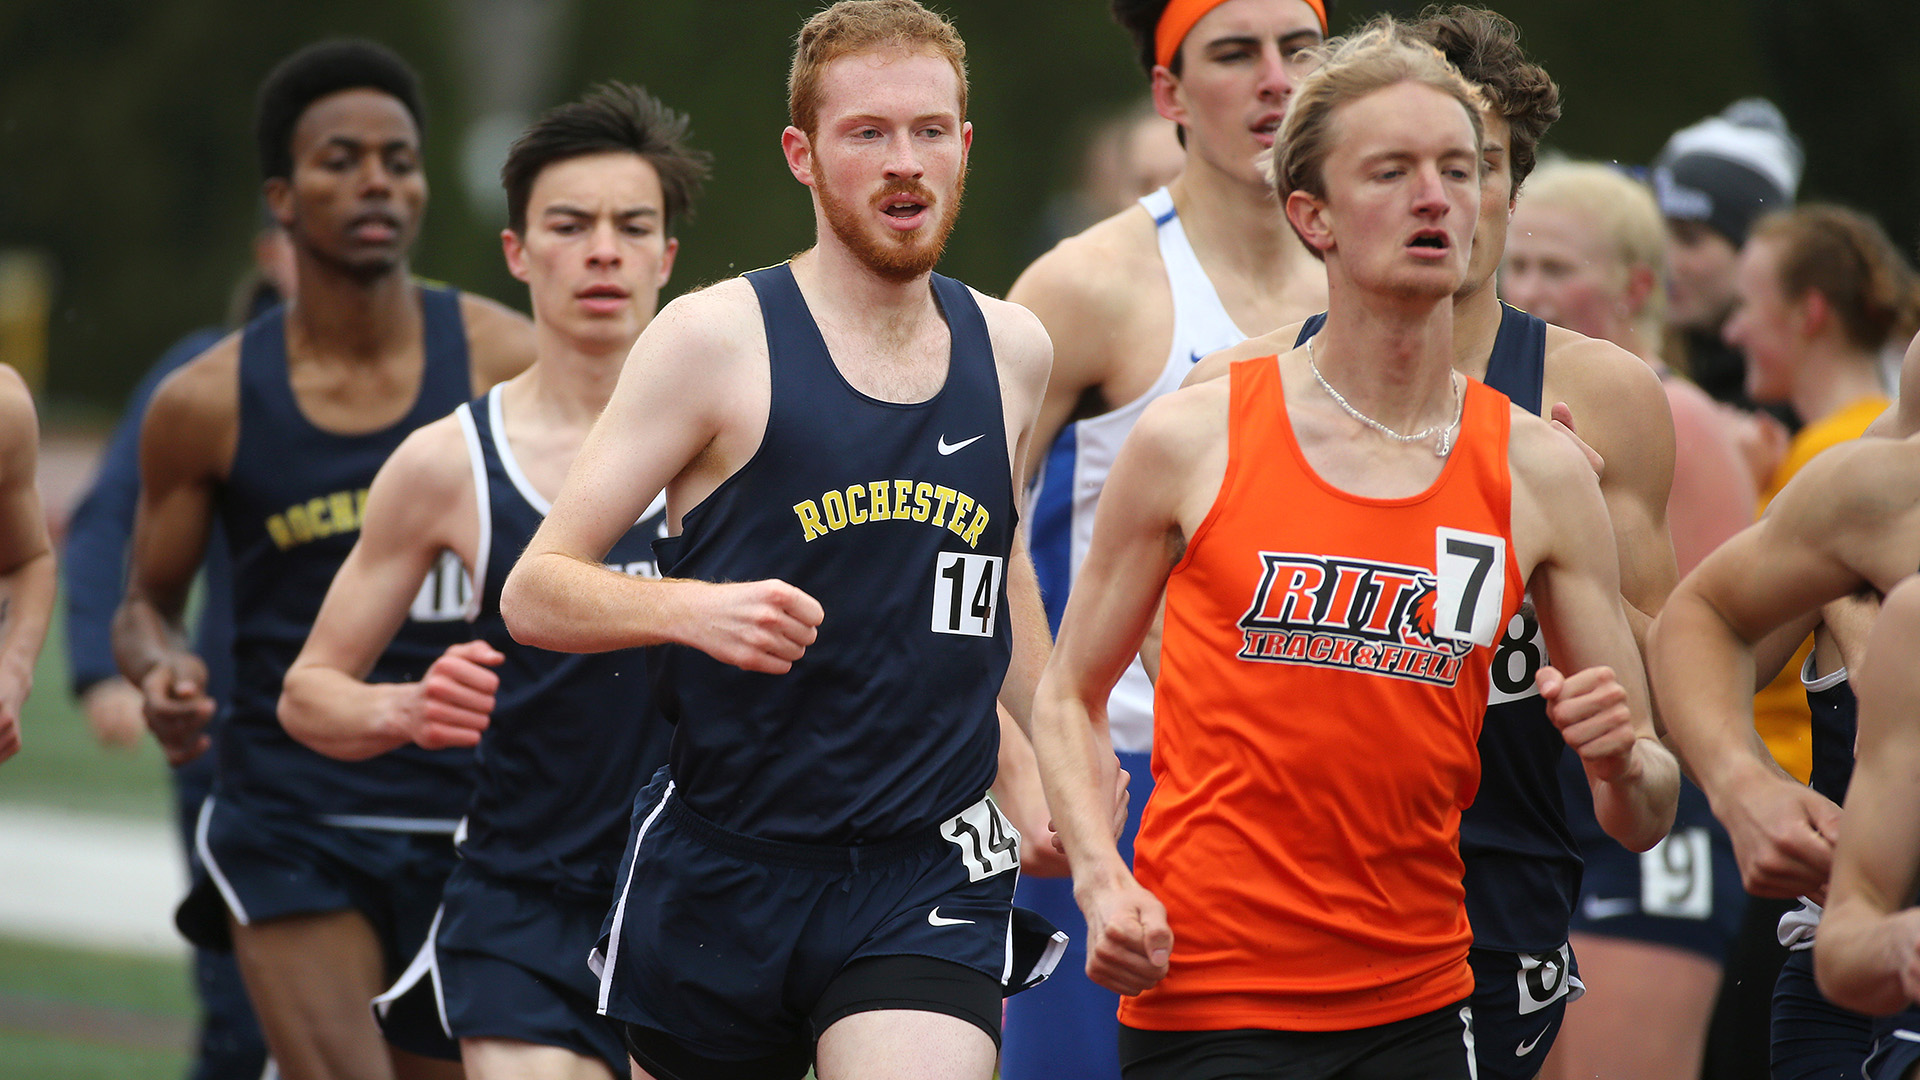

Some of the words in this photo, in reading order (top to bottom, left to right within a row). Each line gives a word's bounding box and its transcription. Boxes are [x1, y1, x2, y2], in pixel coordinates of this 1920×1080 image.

[793, 479, 990, 549] ROCHESTER
[942, 557, 994, 634] 14
[1243, 552, 1425, 638] RIT
[1446, 538, 1496, 634] 7
[1491, 602, 1541, 695] 8
[951, 798, 1018, 874] 14
[1663, 831, 1695, 903] 9
